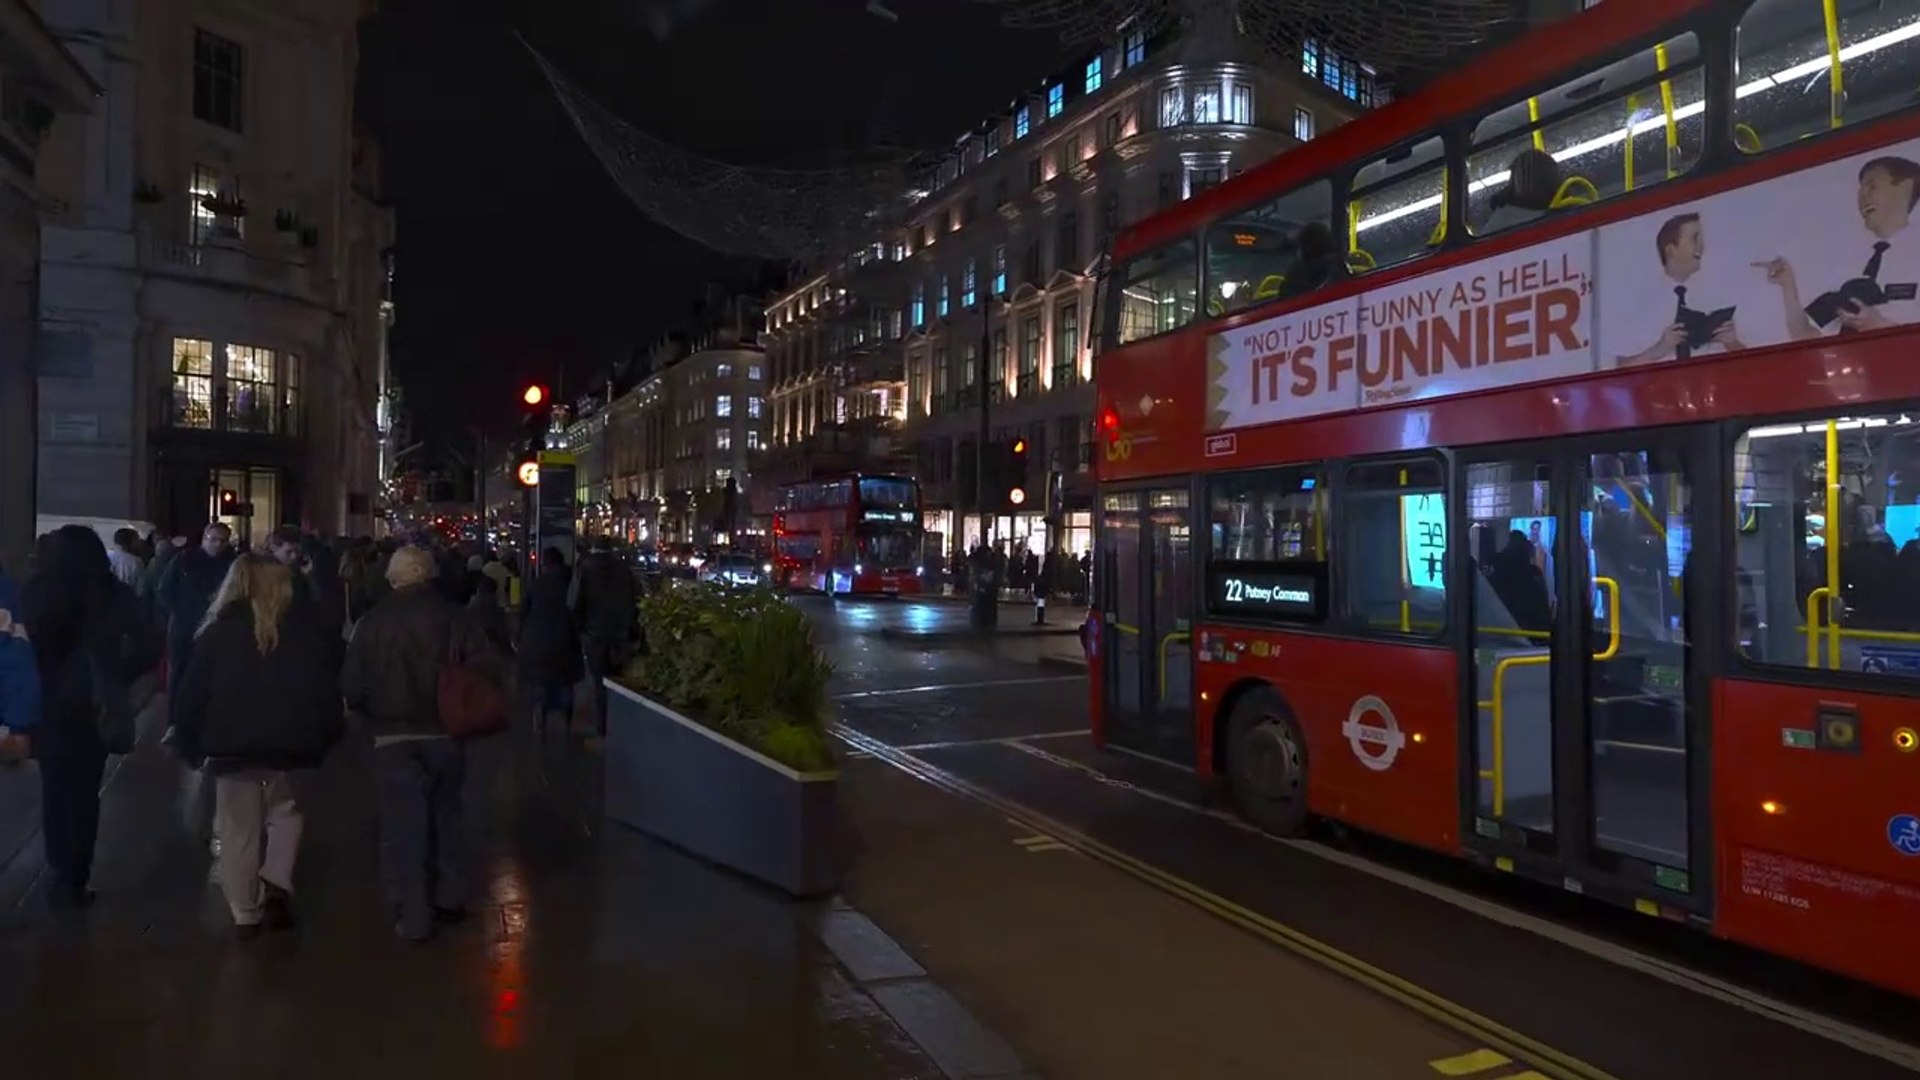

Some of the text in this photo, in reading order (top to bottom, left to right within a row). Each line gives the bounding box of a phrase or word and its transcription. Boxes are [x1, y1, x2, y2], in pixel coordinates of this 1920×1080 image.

[1296, 310, 1349, 345] JUST
[1356, 288, 1443, 332] FUNNY
[1450, 276, 1487, 309] AS
[1252, 345, 1317, 406] IT'S
[1225, 579, 1309, 603] 22 Putney Common
